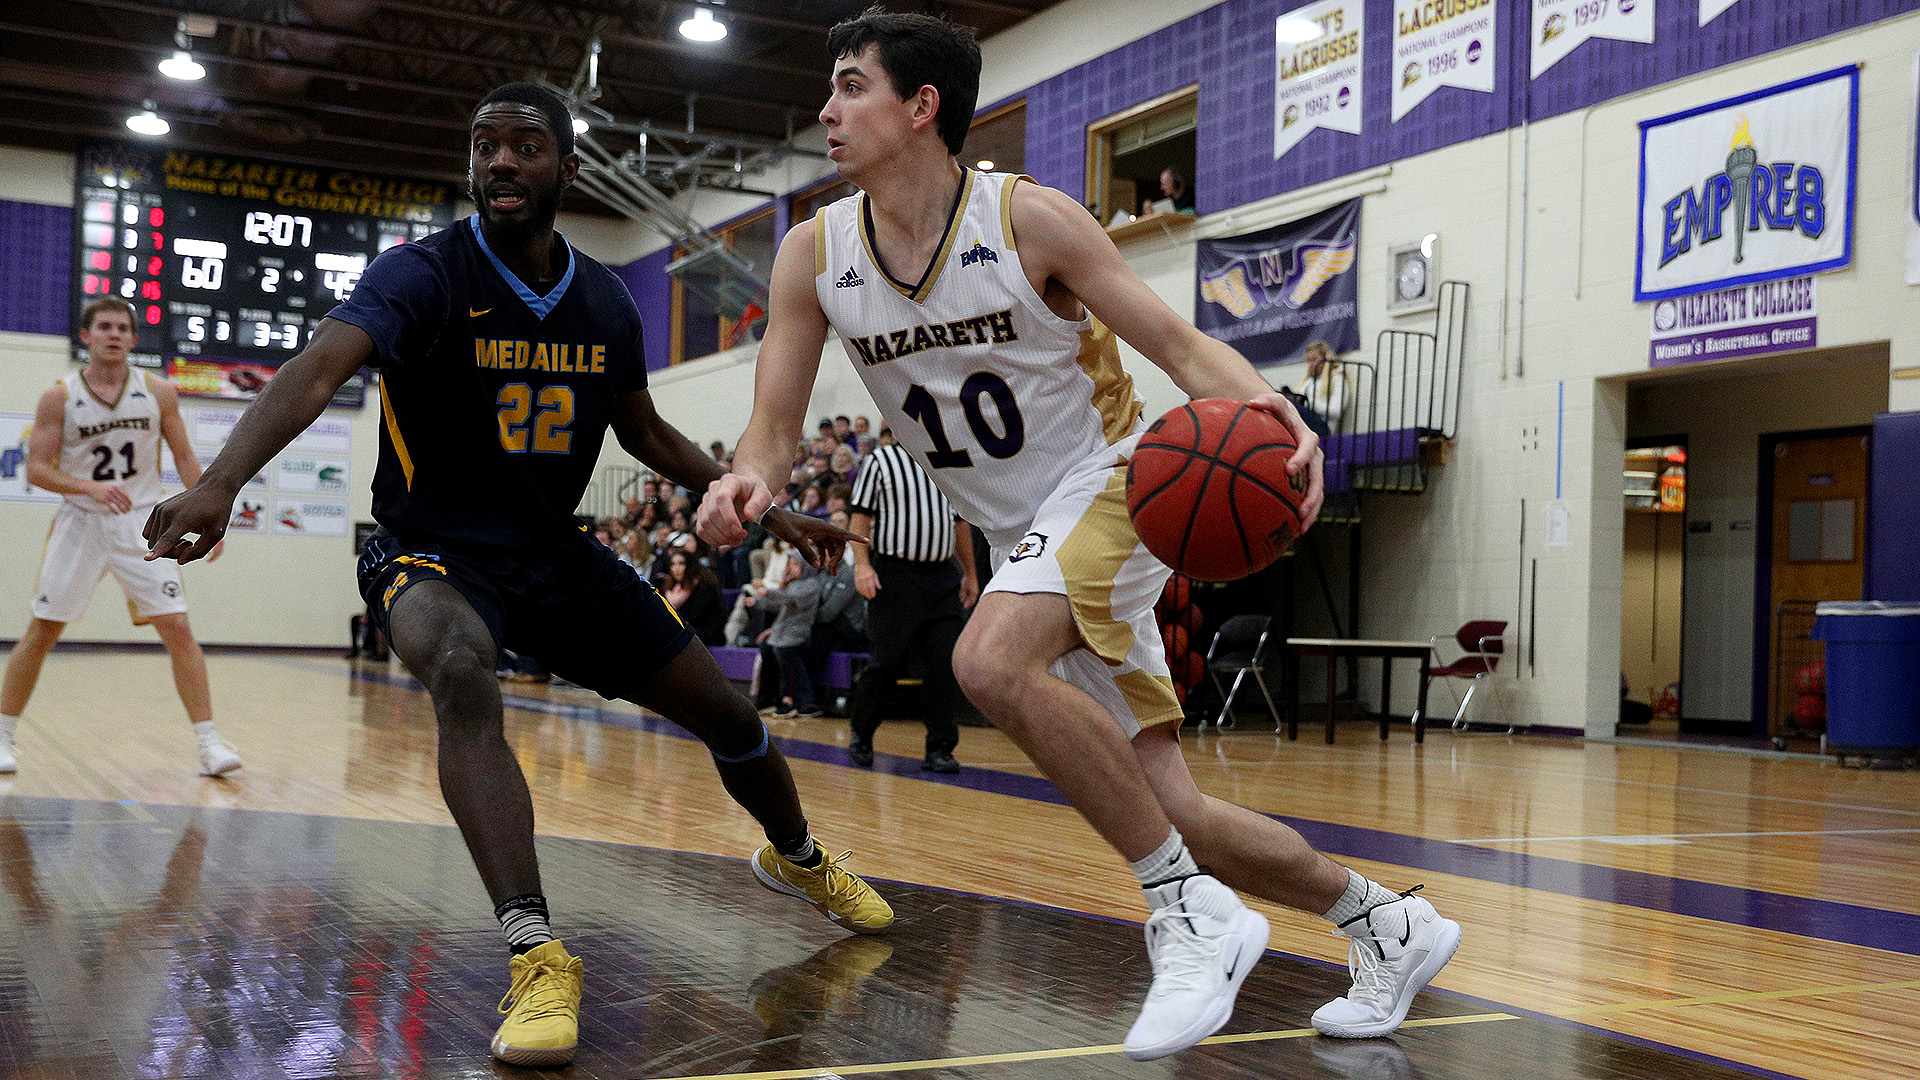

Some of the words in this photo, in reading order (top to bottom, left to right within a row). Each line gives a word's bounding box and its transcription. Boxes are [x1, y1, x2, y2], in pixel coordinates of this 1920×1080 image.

[1398, 0, 1491, 37] LACROS
[1440, 18, 1489, 44] CHAMPIONS
[1280, 30, 1359, 82] LACROSSE
[1428, 47, 1458, 77] 1996
[163, 152, 319, 192] NAZARETH
[329, 171, 447, 206] COLLEGE
[244, 211, 314, 249] 12:07
[181, 256, 225, 291] 60
[260, 267, 281, 293] 2
[1679, 286, 1748, 330] NAZARETH
[1752, 276, 1813, 318] COLLEGE
[187, 316, 206, 342] 5
[847, 308, 1020, 368] NAZARETH
[474, 337, 607, 374] MEDAILLE
[495, 382, 576, 455] 22
[900, 370, 1027, 470] 10
[92, 441, 138, 481] 21
